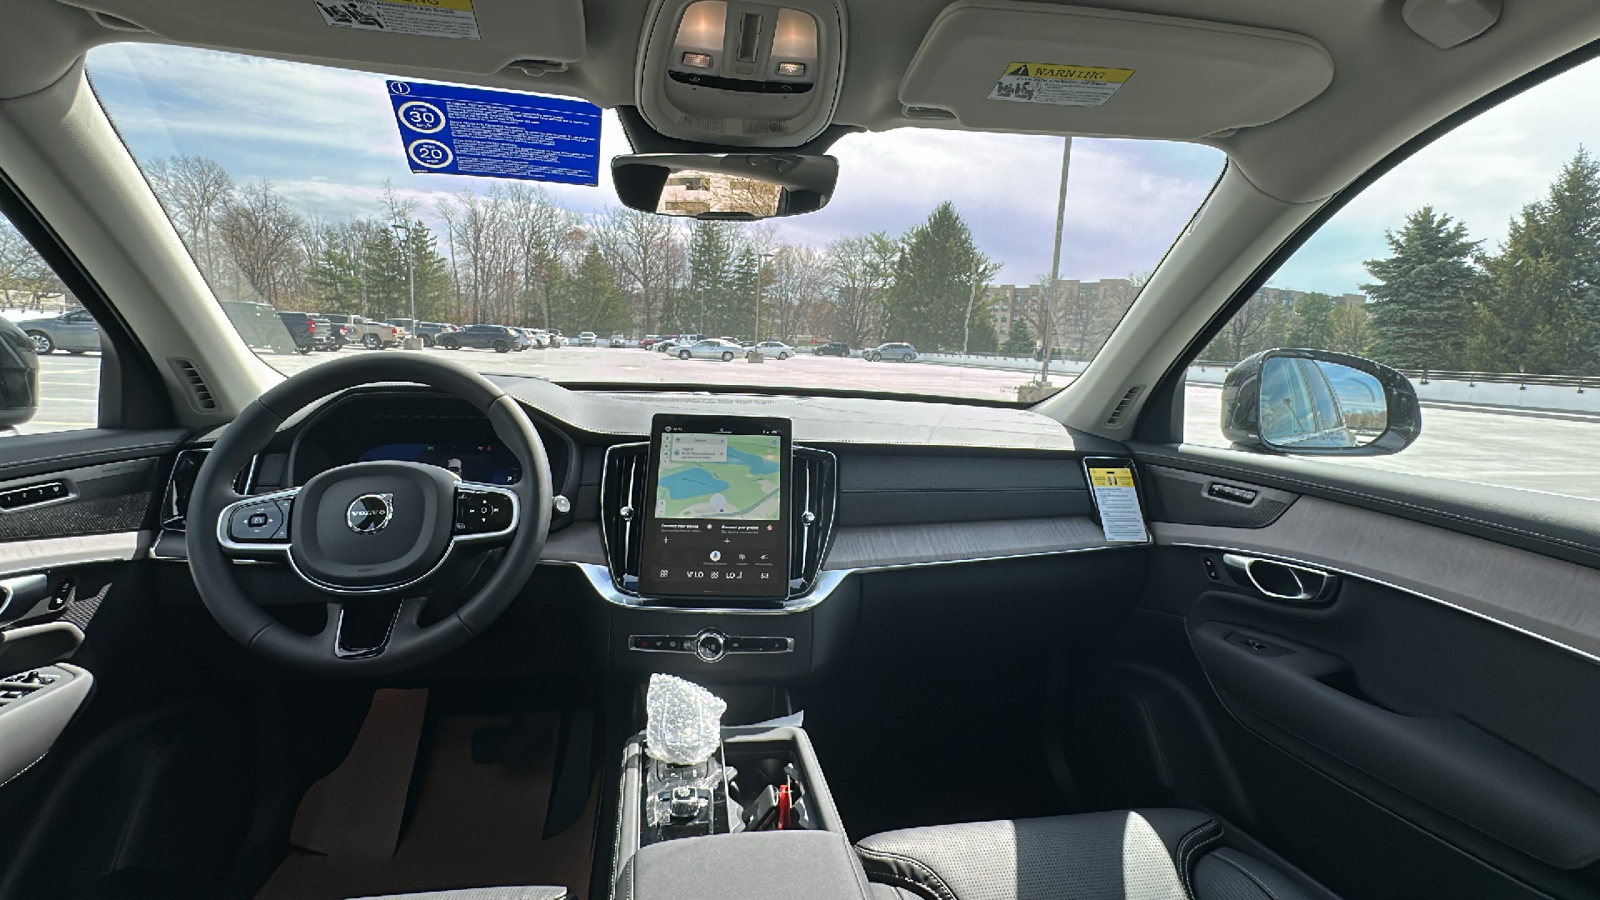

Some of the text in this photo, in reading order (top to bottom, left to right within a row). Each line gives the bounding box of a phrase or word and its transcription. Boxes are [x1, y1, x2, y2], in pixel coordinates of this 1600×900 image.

[1034, 67, 1106, 79] WARNING
[409, 111, 434, 124] 30
[419, 148, 442, 159] 20
